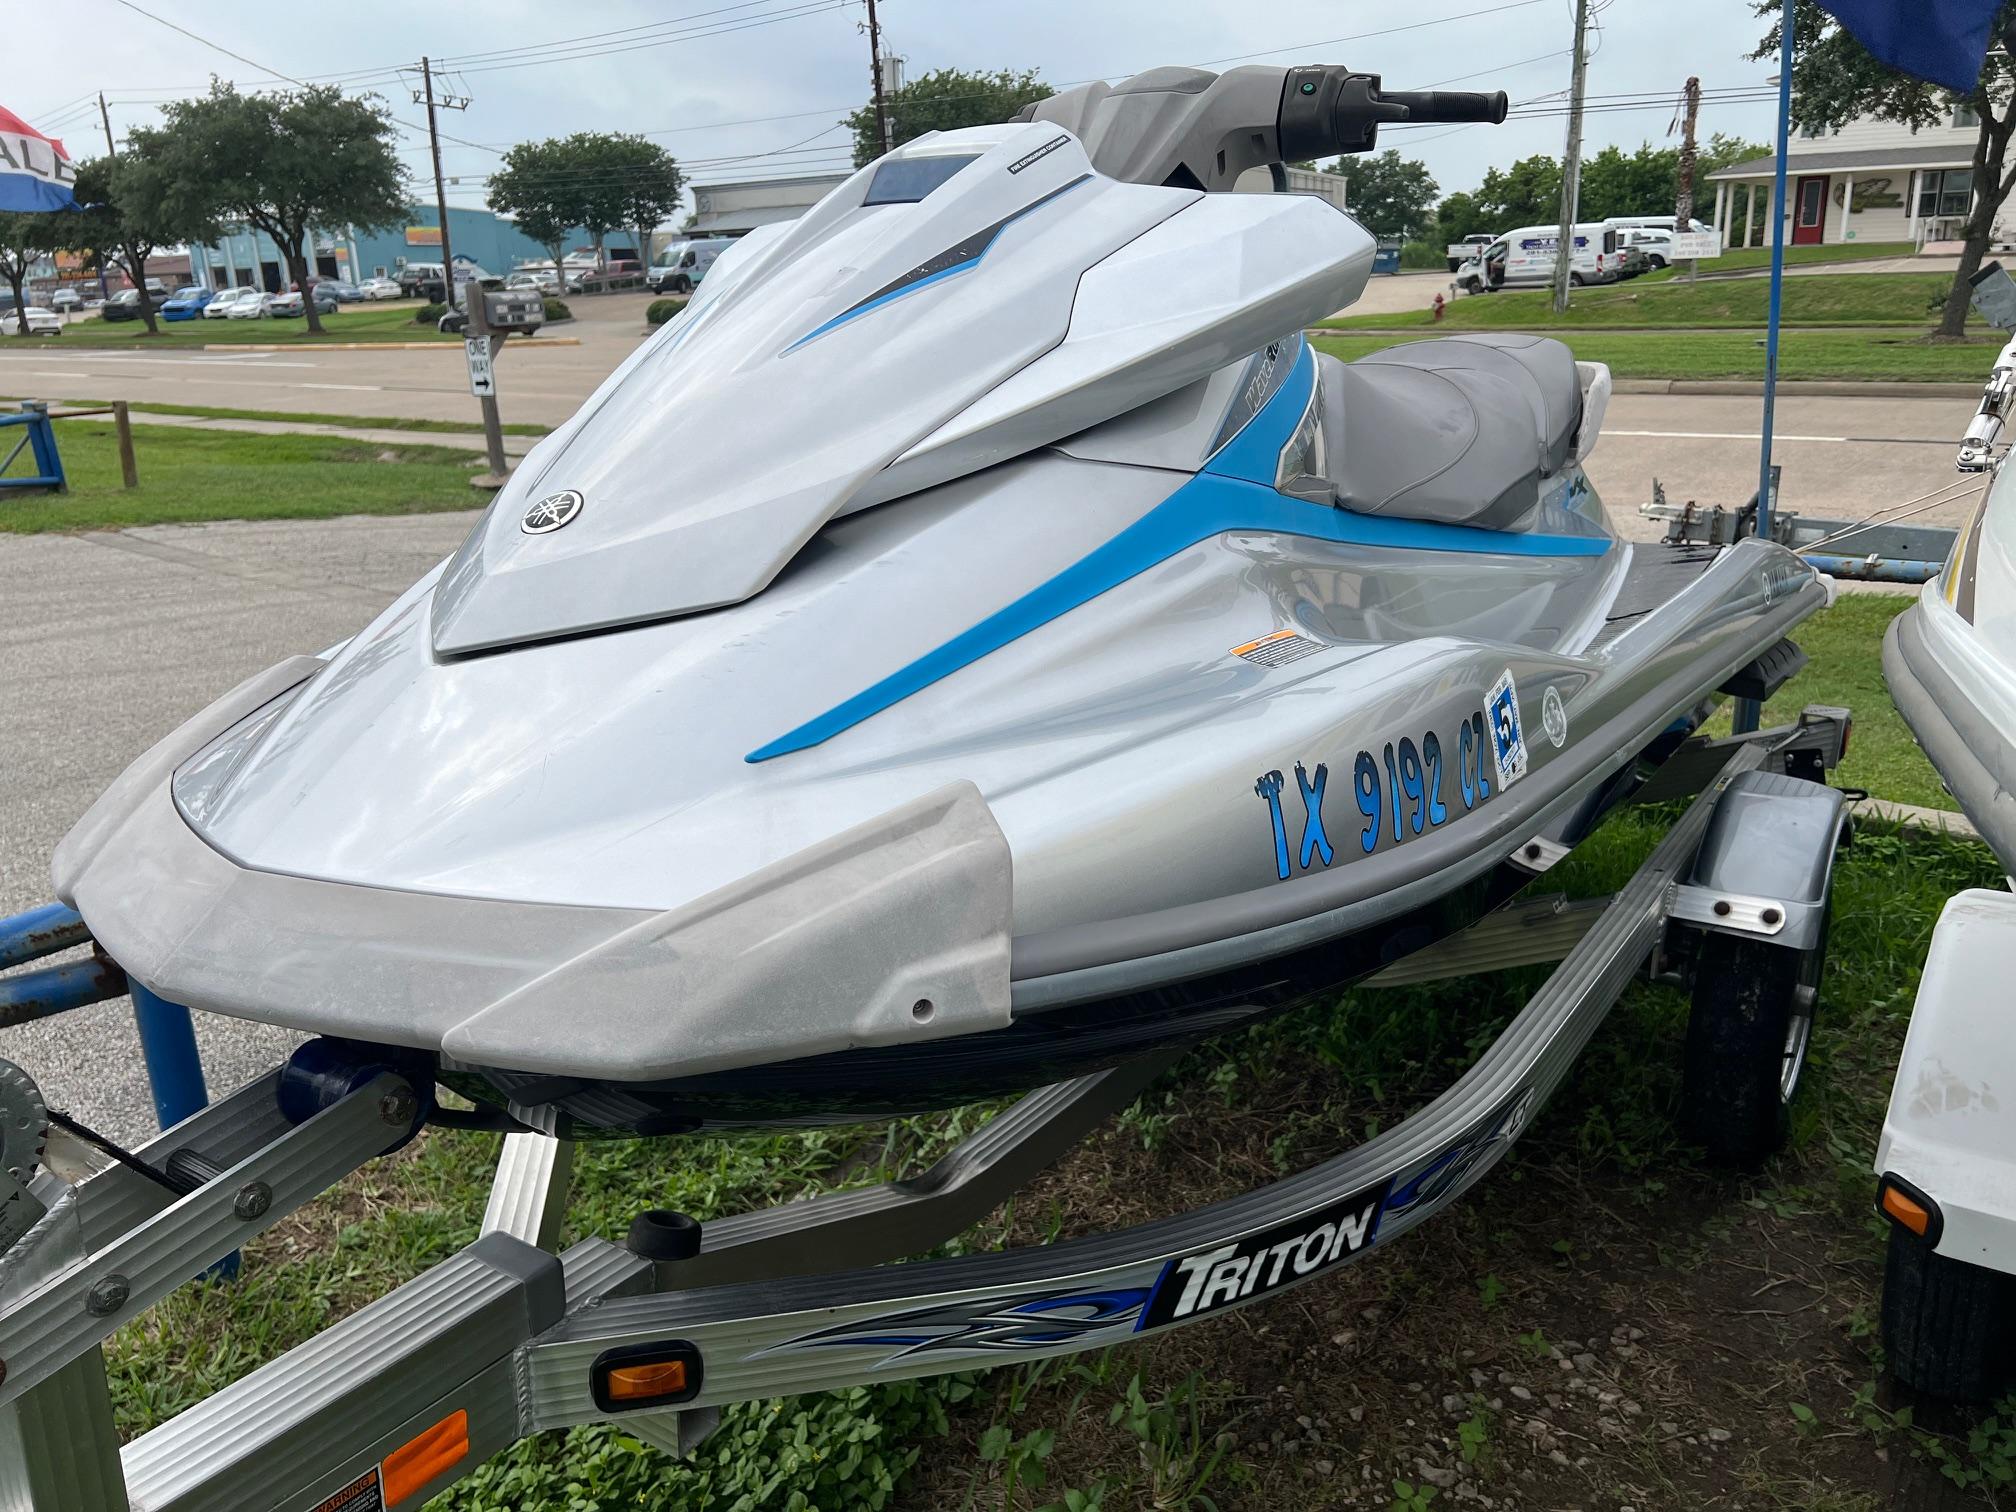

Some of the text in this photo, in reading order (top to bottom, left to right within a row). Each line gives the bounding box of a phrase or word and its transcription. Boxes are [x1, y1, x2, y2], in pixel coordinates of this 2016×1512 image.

[1010, 163, 1022, 172] FIRE
[468, 340, 487, 356] ONE
[471, 360, 490, 375] WAY
[1497, 697, 1513, 750] 5
[1254, 760, 1335, 881] TX
[1353, 730, 1447, 854] 9192
[1173, 1202, 1377, 1319] TRITON
